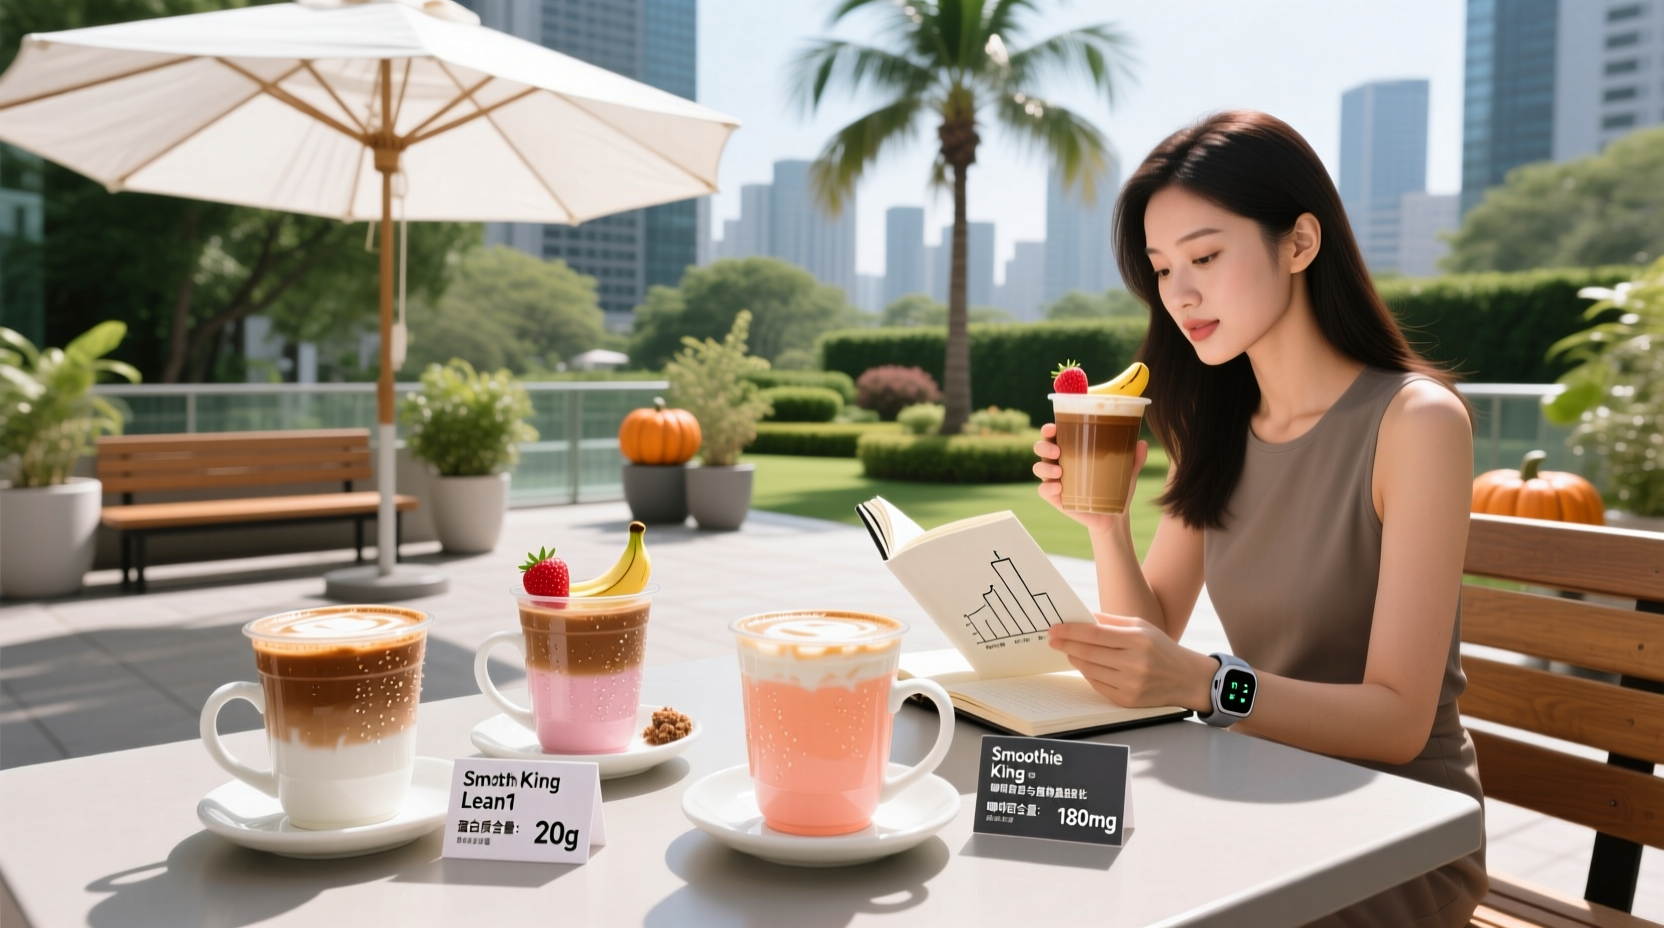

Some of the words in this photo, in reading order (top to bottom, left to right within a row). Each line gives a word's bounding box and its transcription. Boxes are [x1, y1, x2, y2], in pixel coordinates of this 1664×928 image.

[992, 746, 1063, 765] Smoothie
[520, 770, 561, 794] King
[461, 791, 516, 811] Lean1
[1057, 807, 1118, 835] 180mg
[533, 820, 580, 852] 20g
